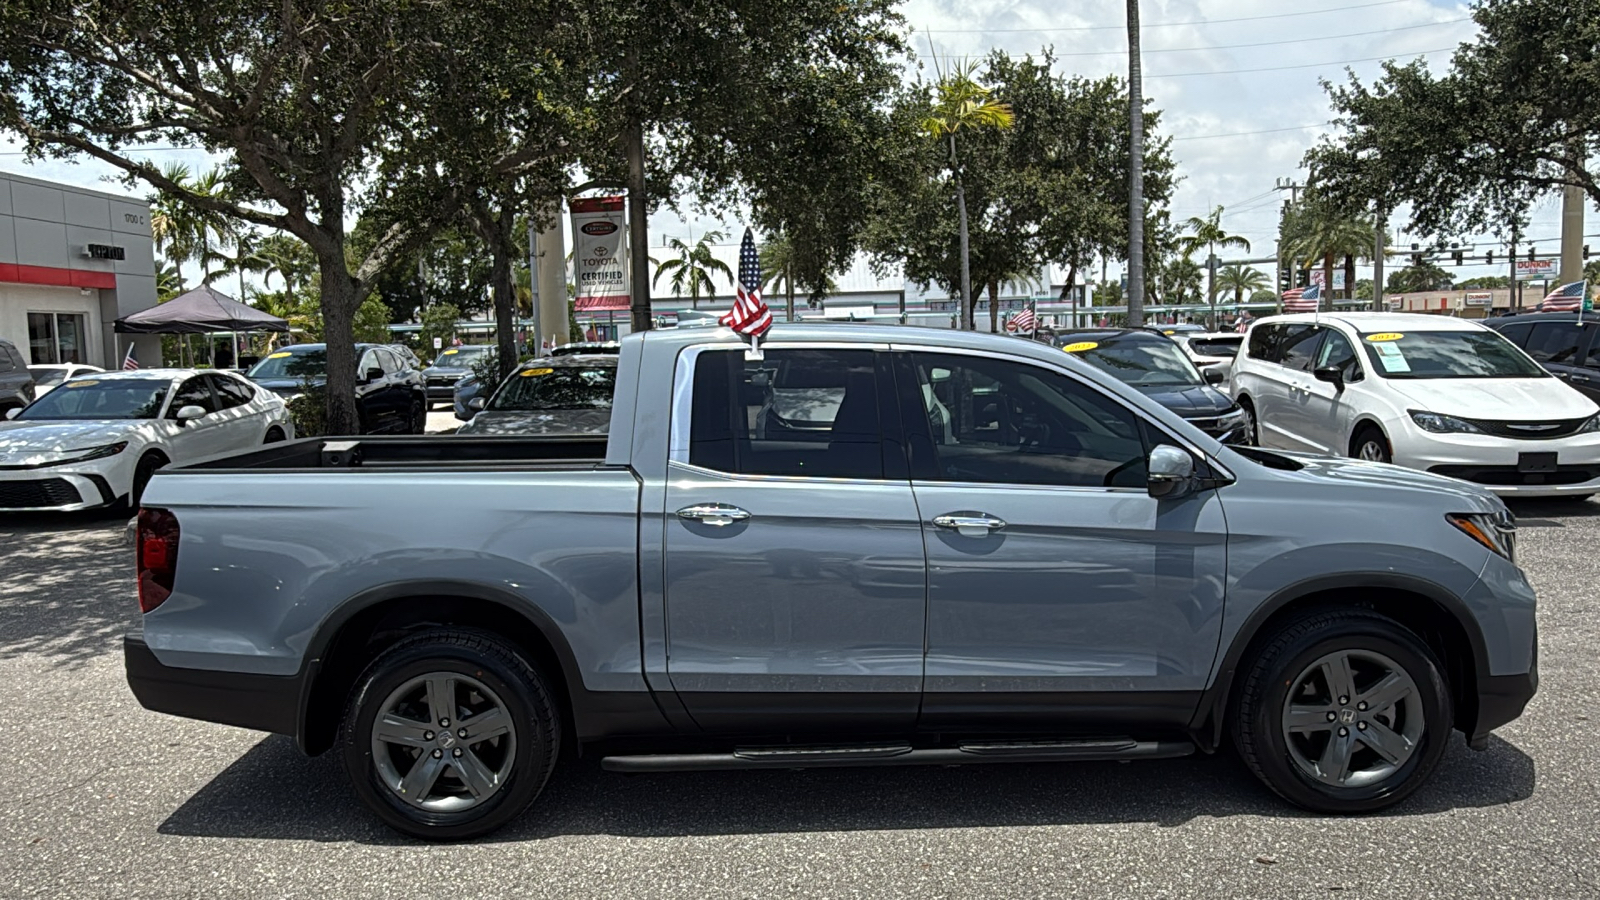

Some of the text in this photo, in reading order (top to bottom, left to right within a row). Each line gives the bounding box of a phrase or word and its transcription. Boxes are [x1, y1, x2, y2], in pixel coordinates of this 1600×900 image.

[124, 213, 144, 225] 1700 C
[582, 258, 618, 266] TOYOTA
[581, 271, 622, 281] CERTIFIED
